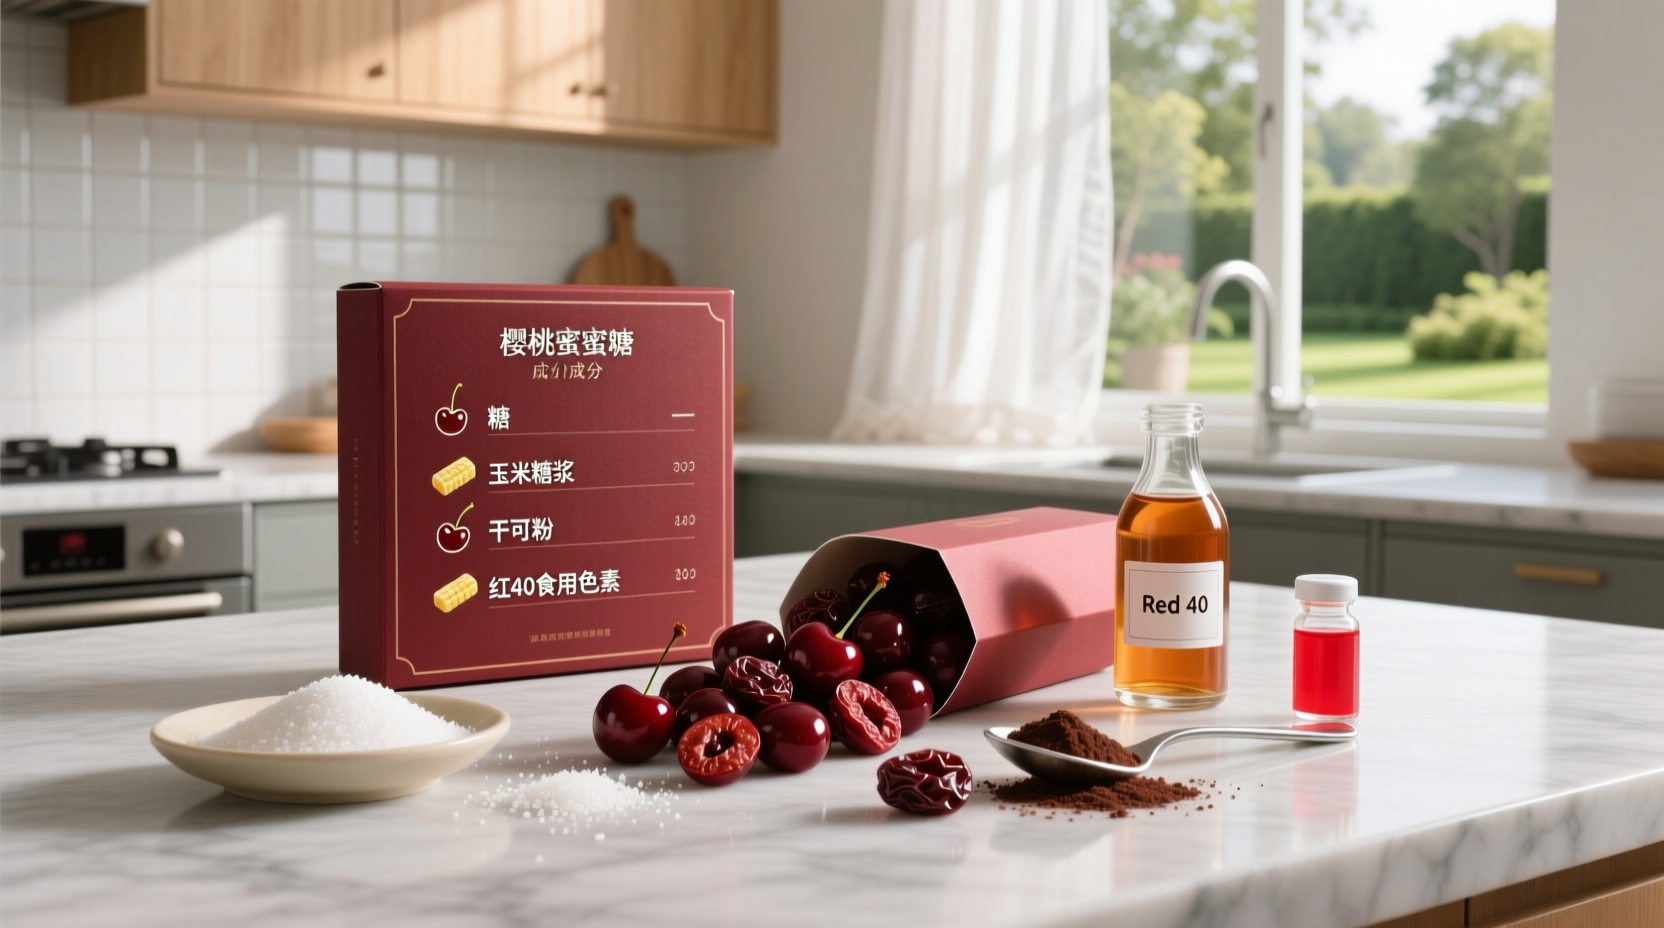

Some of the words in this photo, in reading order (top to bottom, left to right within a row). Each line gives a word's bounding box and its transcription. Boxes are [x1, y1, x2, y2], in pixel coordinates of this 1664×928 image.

[487, 405, 510, 430] 糖
[488, 516, 554, 543] 干可粉
[488, 568, 621, 600] 红40食用色素
[1142, 594, 1180, 614] Red
[1186, 595, 1208, 614] 40
